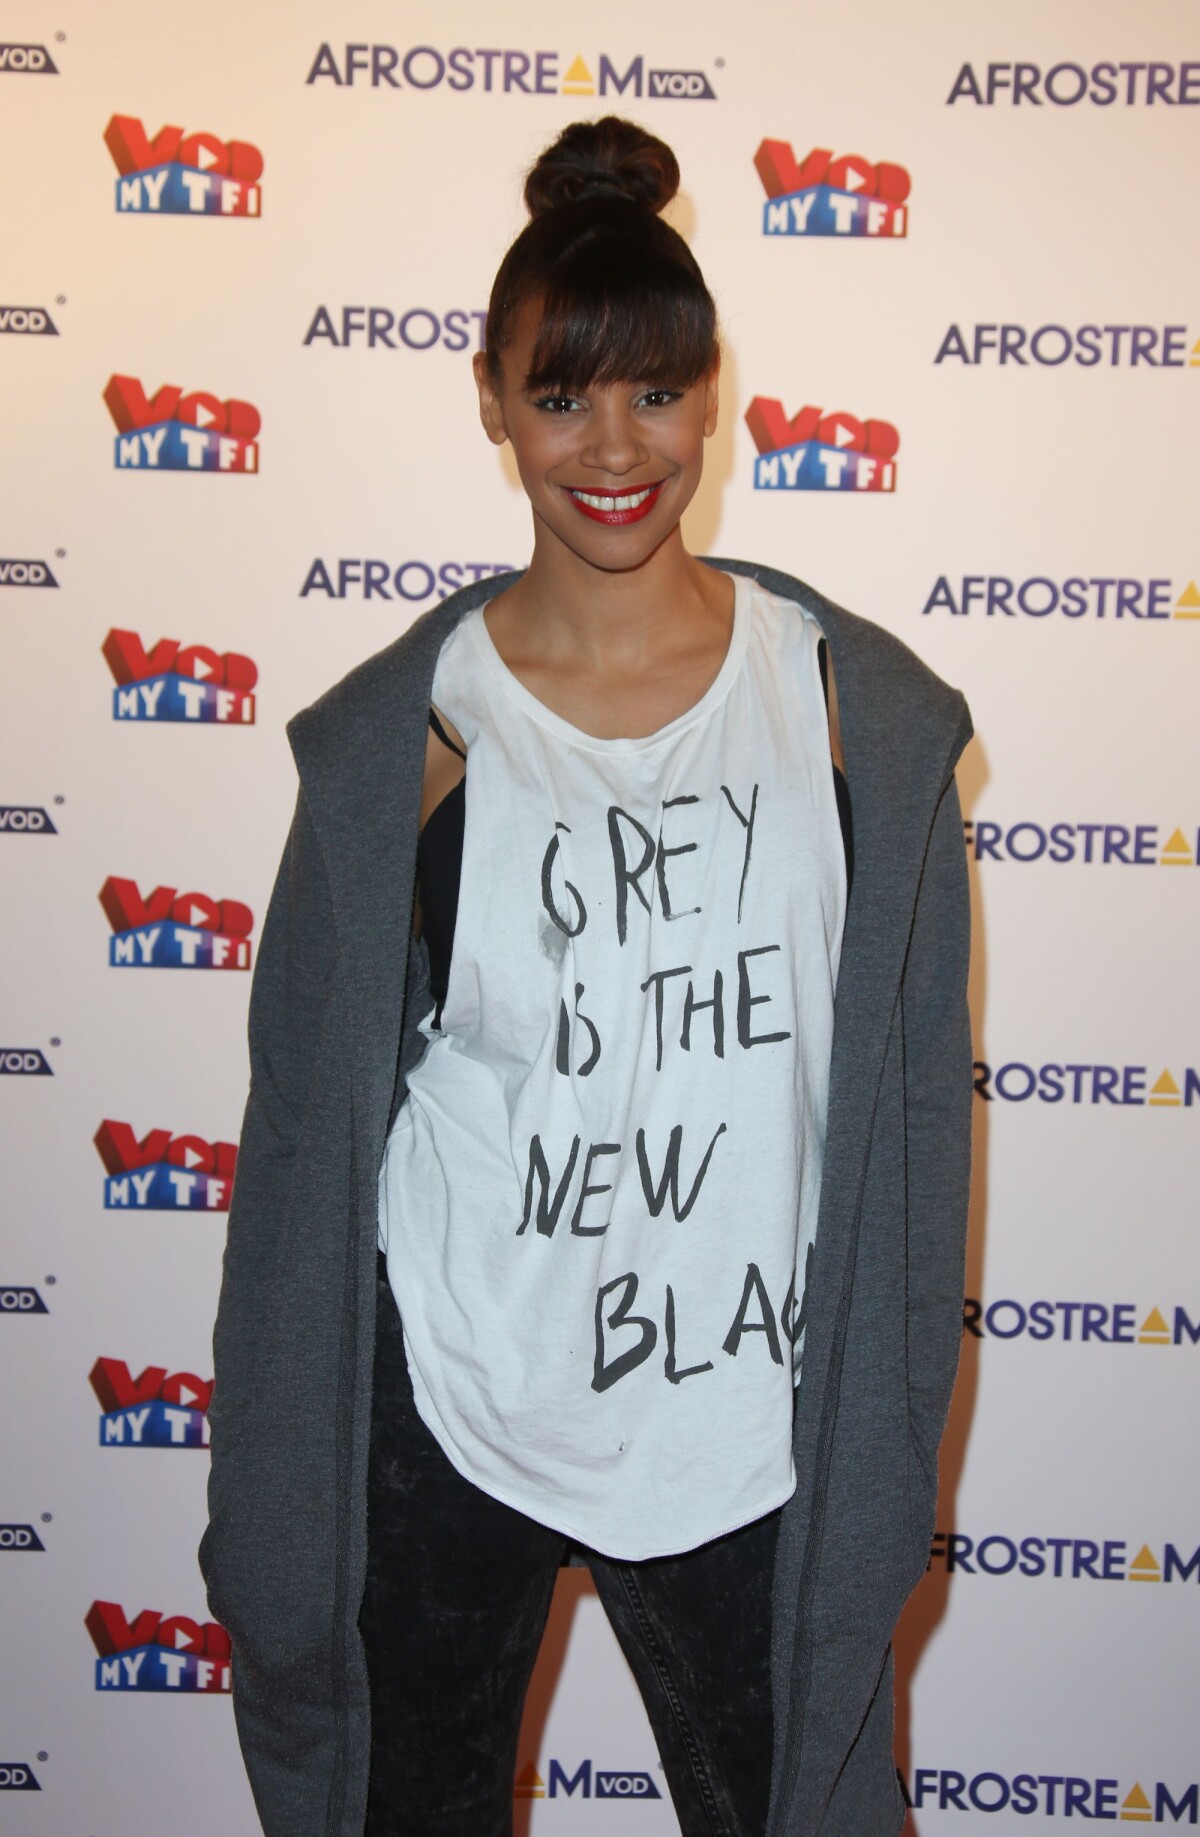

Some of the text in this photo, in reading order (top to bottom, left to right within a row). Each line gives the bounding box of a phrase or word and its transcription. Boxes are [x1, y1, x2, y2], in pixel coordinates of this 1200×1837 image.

[652, 75, 704, 97] VOD
[103, 113, 264, 184] VOD
[753, 137, 911, 203] VOD
[934, 324, 1200, 367] AFROSTRE
[103, 373, 261, 440] VOD
[744, 395, 900, 459] VOD
[101, 627, 258, 692] VOD
[541, 784, 758, 946] GREY
[98, 876, 254, 937] VOD
[641, 944, 791, 1072] THE
[516, 1123, 726, 1238] NEW
[88, 1356, 215, 1415] VO
[602, 1777, 648, 1794] VOD
